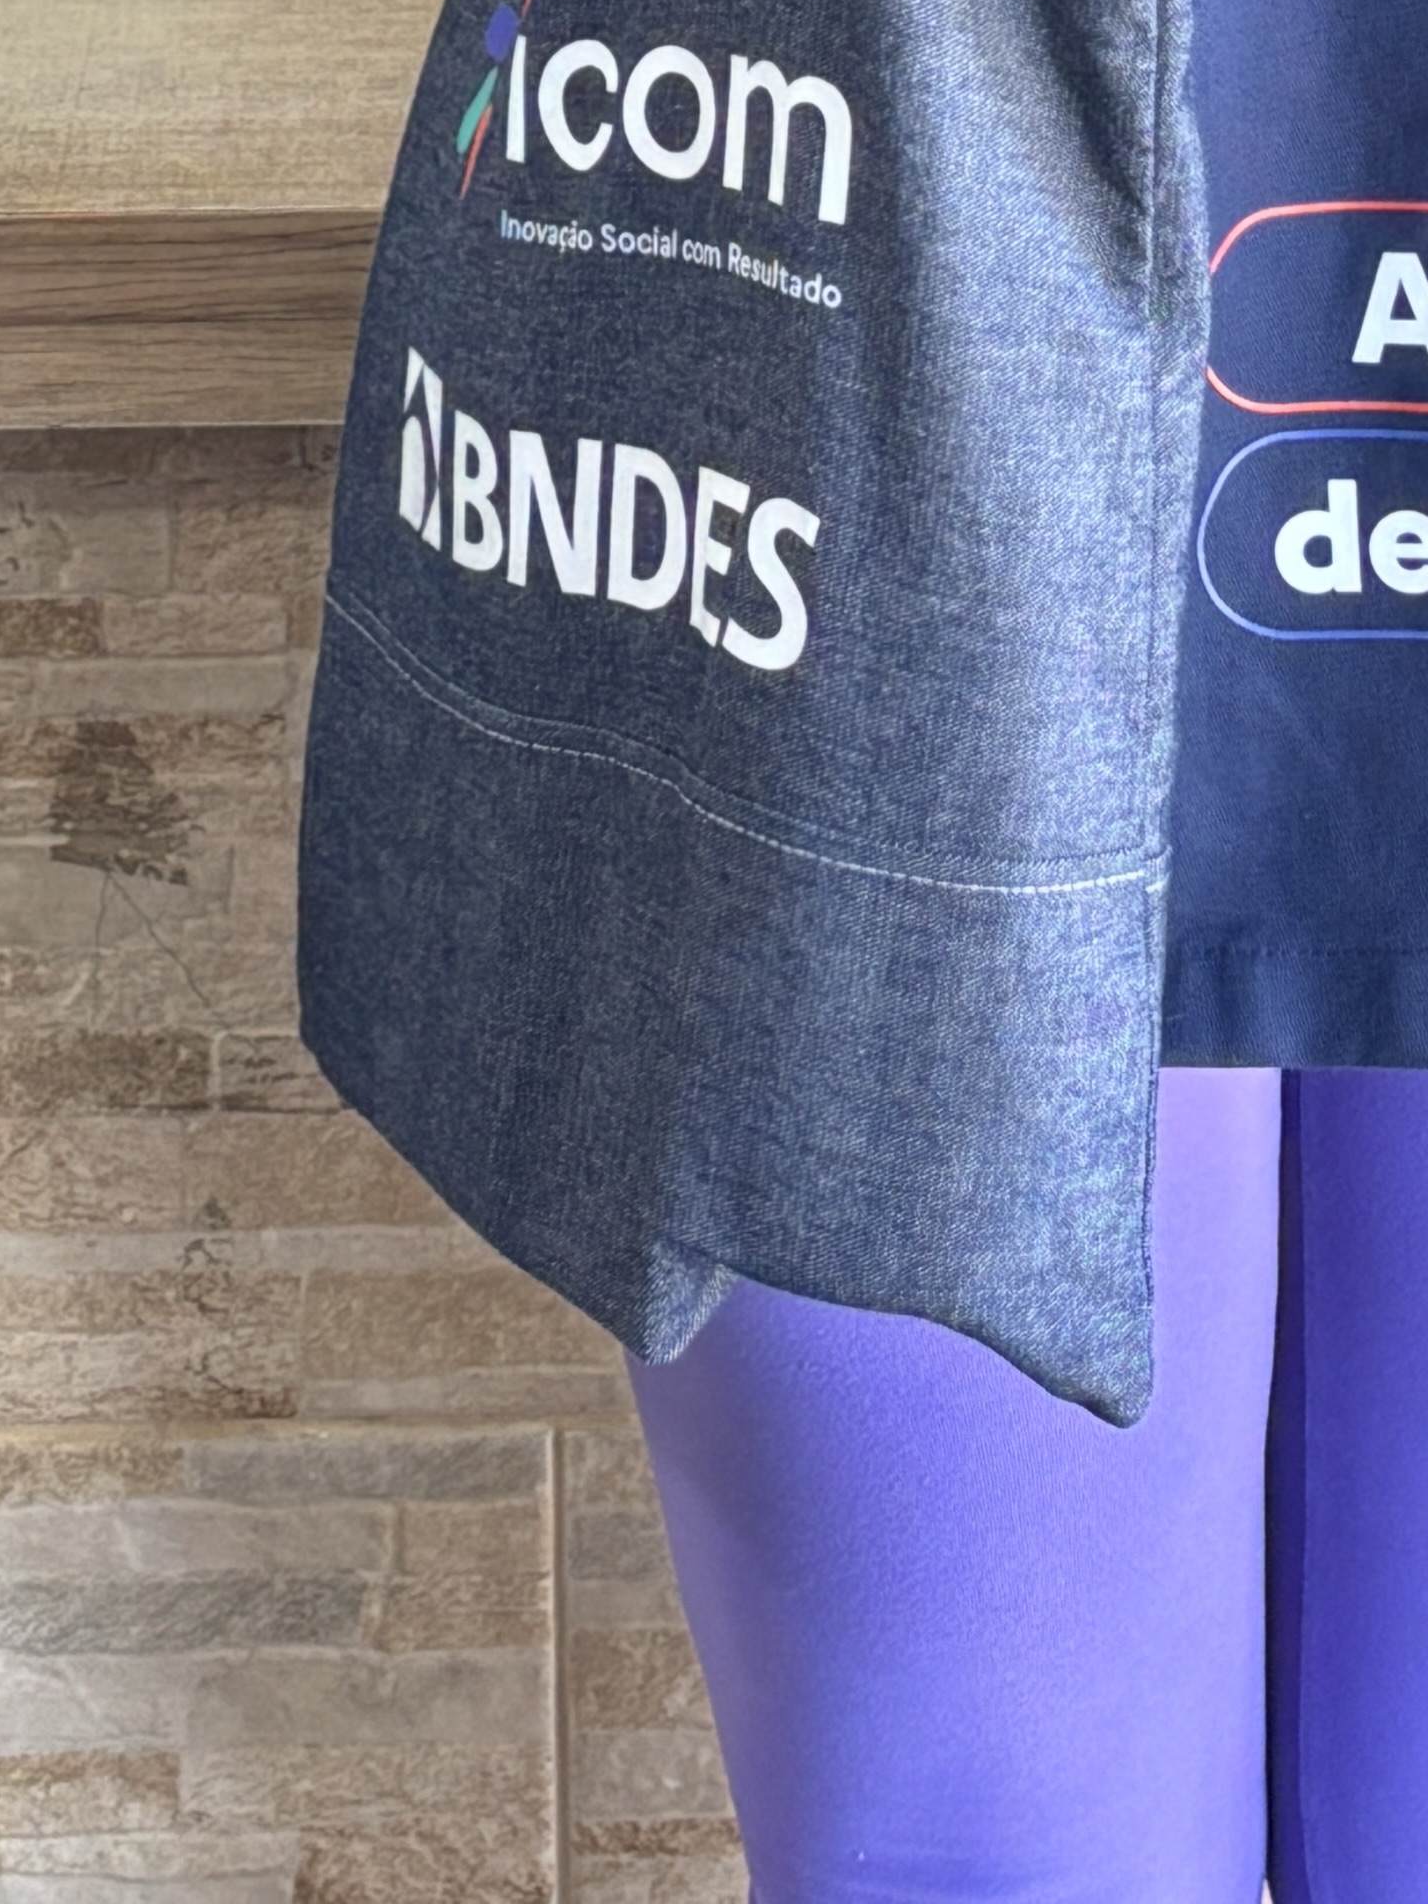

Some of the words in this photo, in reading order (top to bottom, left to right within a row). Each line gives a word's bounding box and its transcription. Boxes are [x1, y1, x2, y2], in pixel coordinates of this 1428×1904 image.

[506, 35, 852, 225] icom
[500, 209, 593, 254] Inovação
[601, 223, 678, 259] Social
[682, 238, 722, 270] com
[728, 242, 843, 309] Resultado
[453, 409, 821, 672] BNDES
